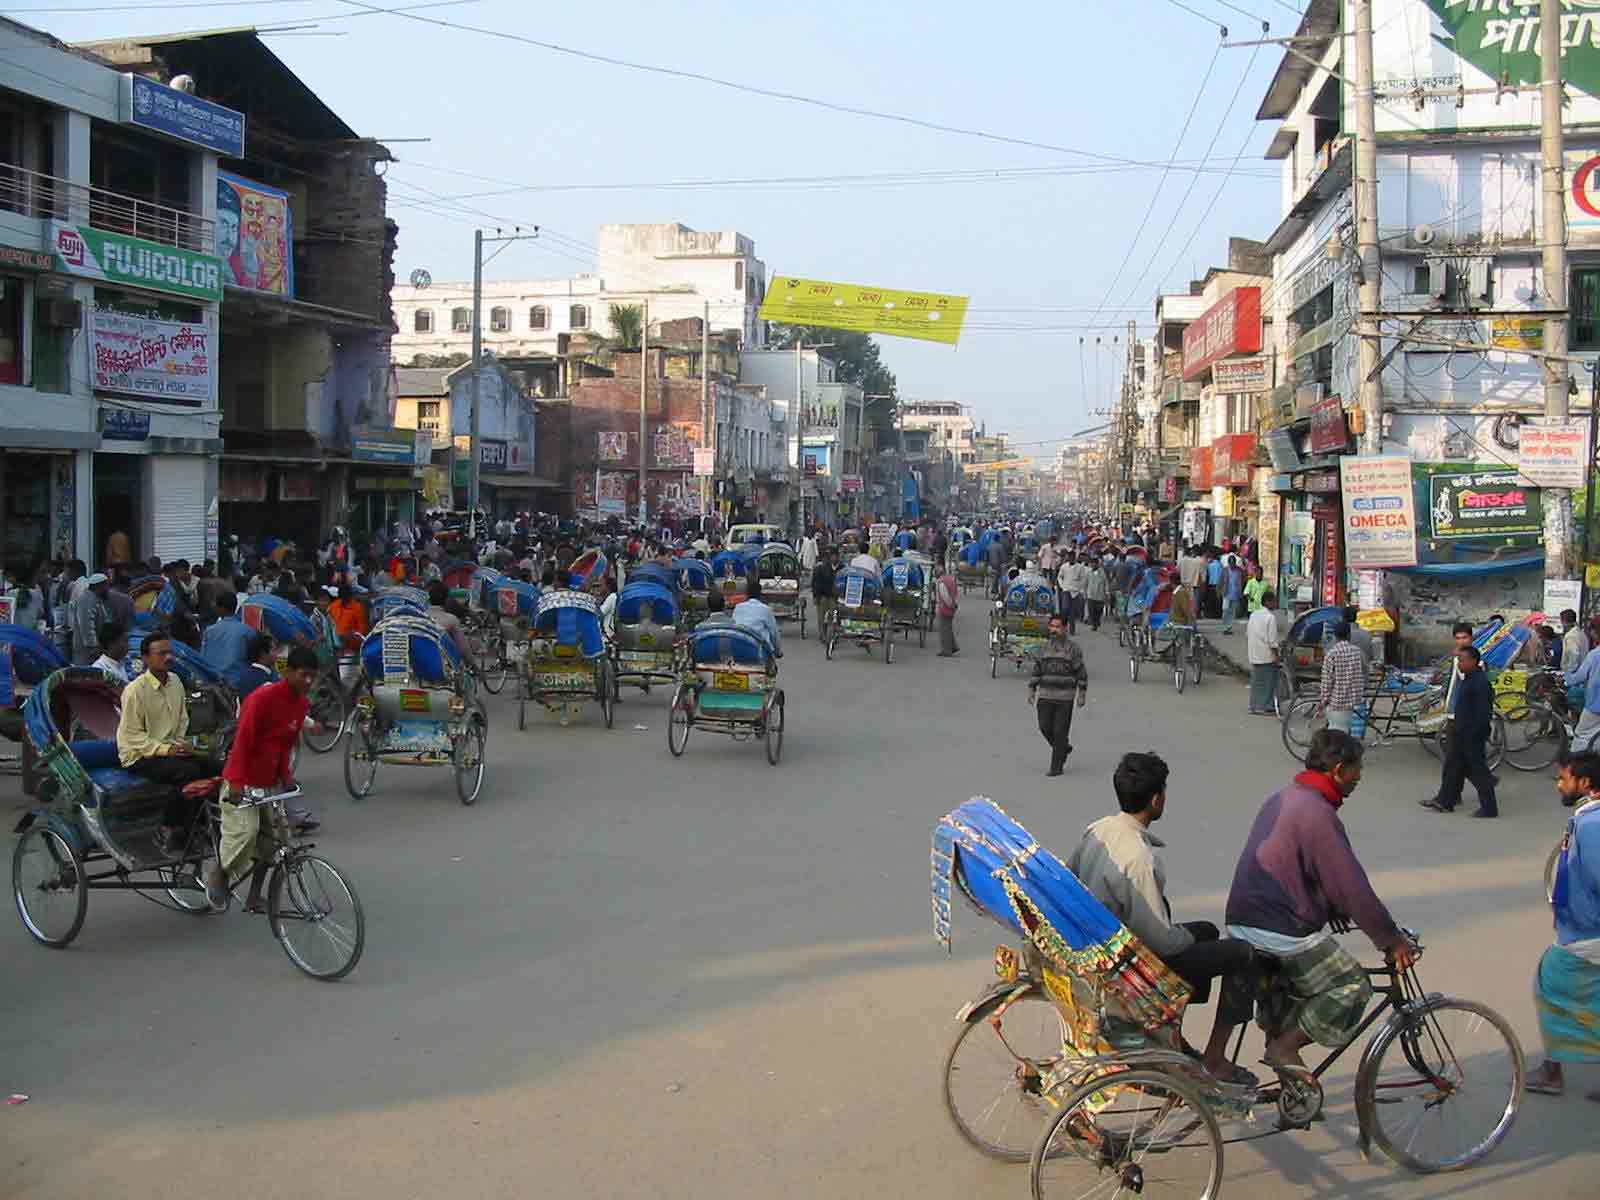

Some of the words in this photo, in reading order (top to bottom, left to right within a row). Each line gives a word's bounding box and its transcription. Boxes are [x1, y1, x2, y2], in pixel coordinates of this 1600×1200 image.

[59, 233, 84, 262] FUJI
[103, 240, 219, 289] FUJICOLOR
[1349, 514, 1408, 529] OMECA
